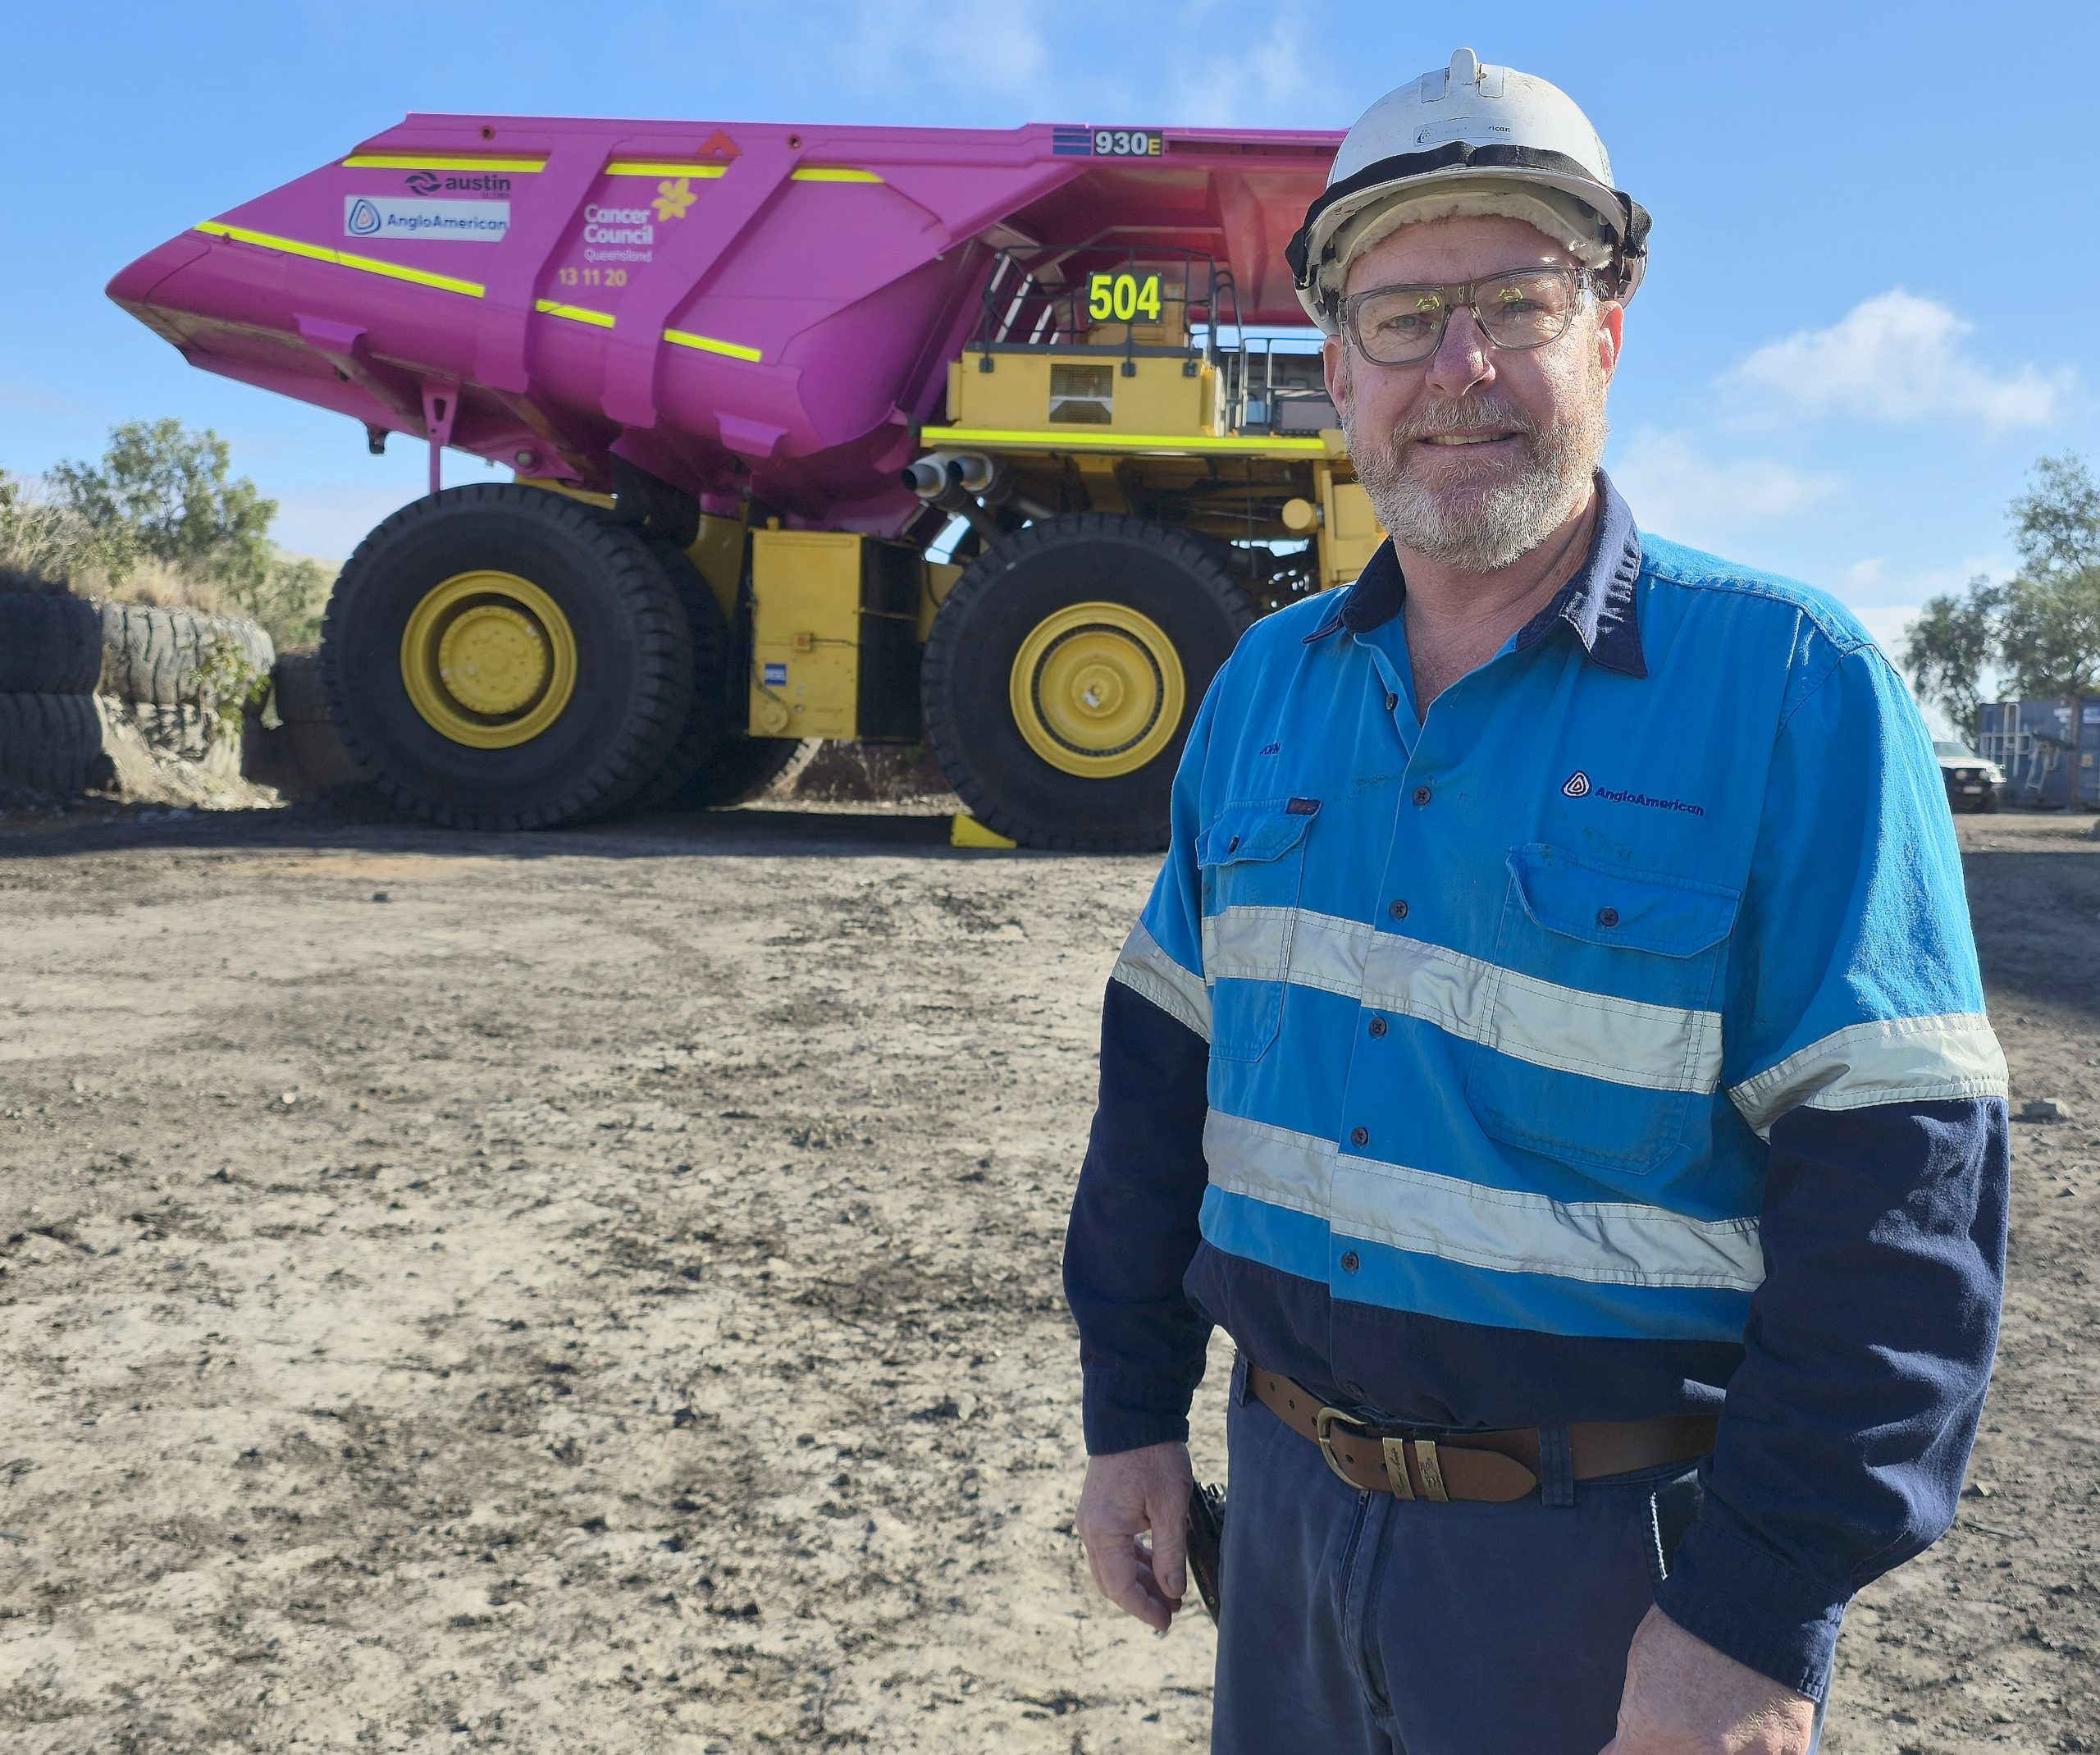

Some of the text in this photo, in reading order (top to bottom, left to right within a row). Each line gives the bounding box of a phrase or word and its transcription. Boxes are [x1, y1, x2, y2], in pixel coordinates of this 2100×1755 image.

[1095, 130, 1161, 156] 930E
[445, 174, 511, 190] austin
[388, 213, 507, 231] AngloAmerican
[584, 203, 651, 224] Cancer
[583, 223, 654, 245] Council
[584, 247, 653, 263] Queensland
[559, 267, 627, 286] 13 11 20
[1089, 274, 1162, 320] 504
[1594, 786, 1705, 817] AngloAmerican
